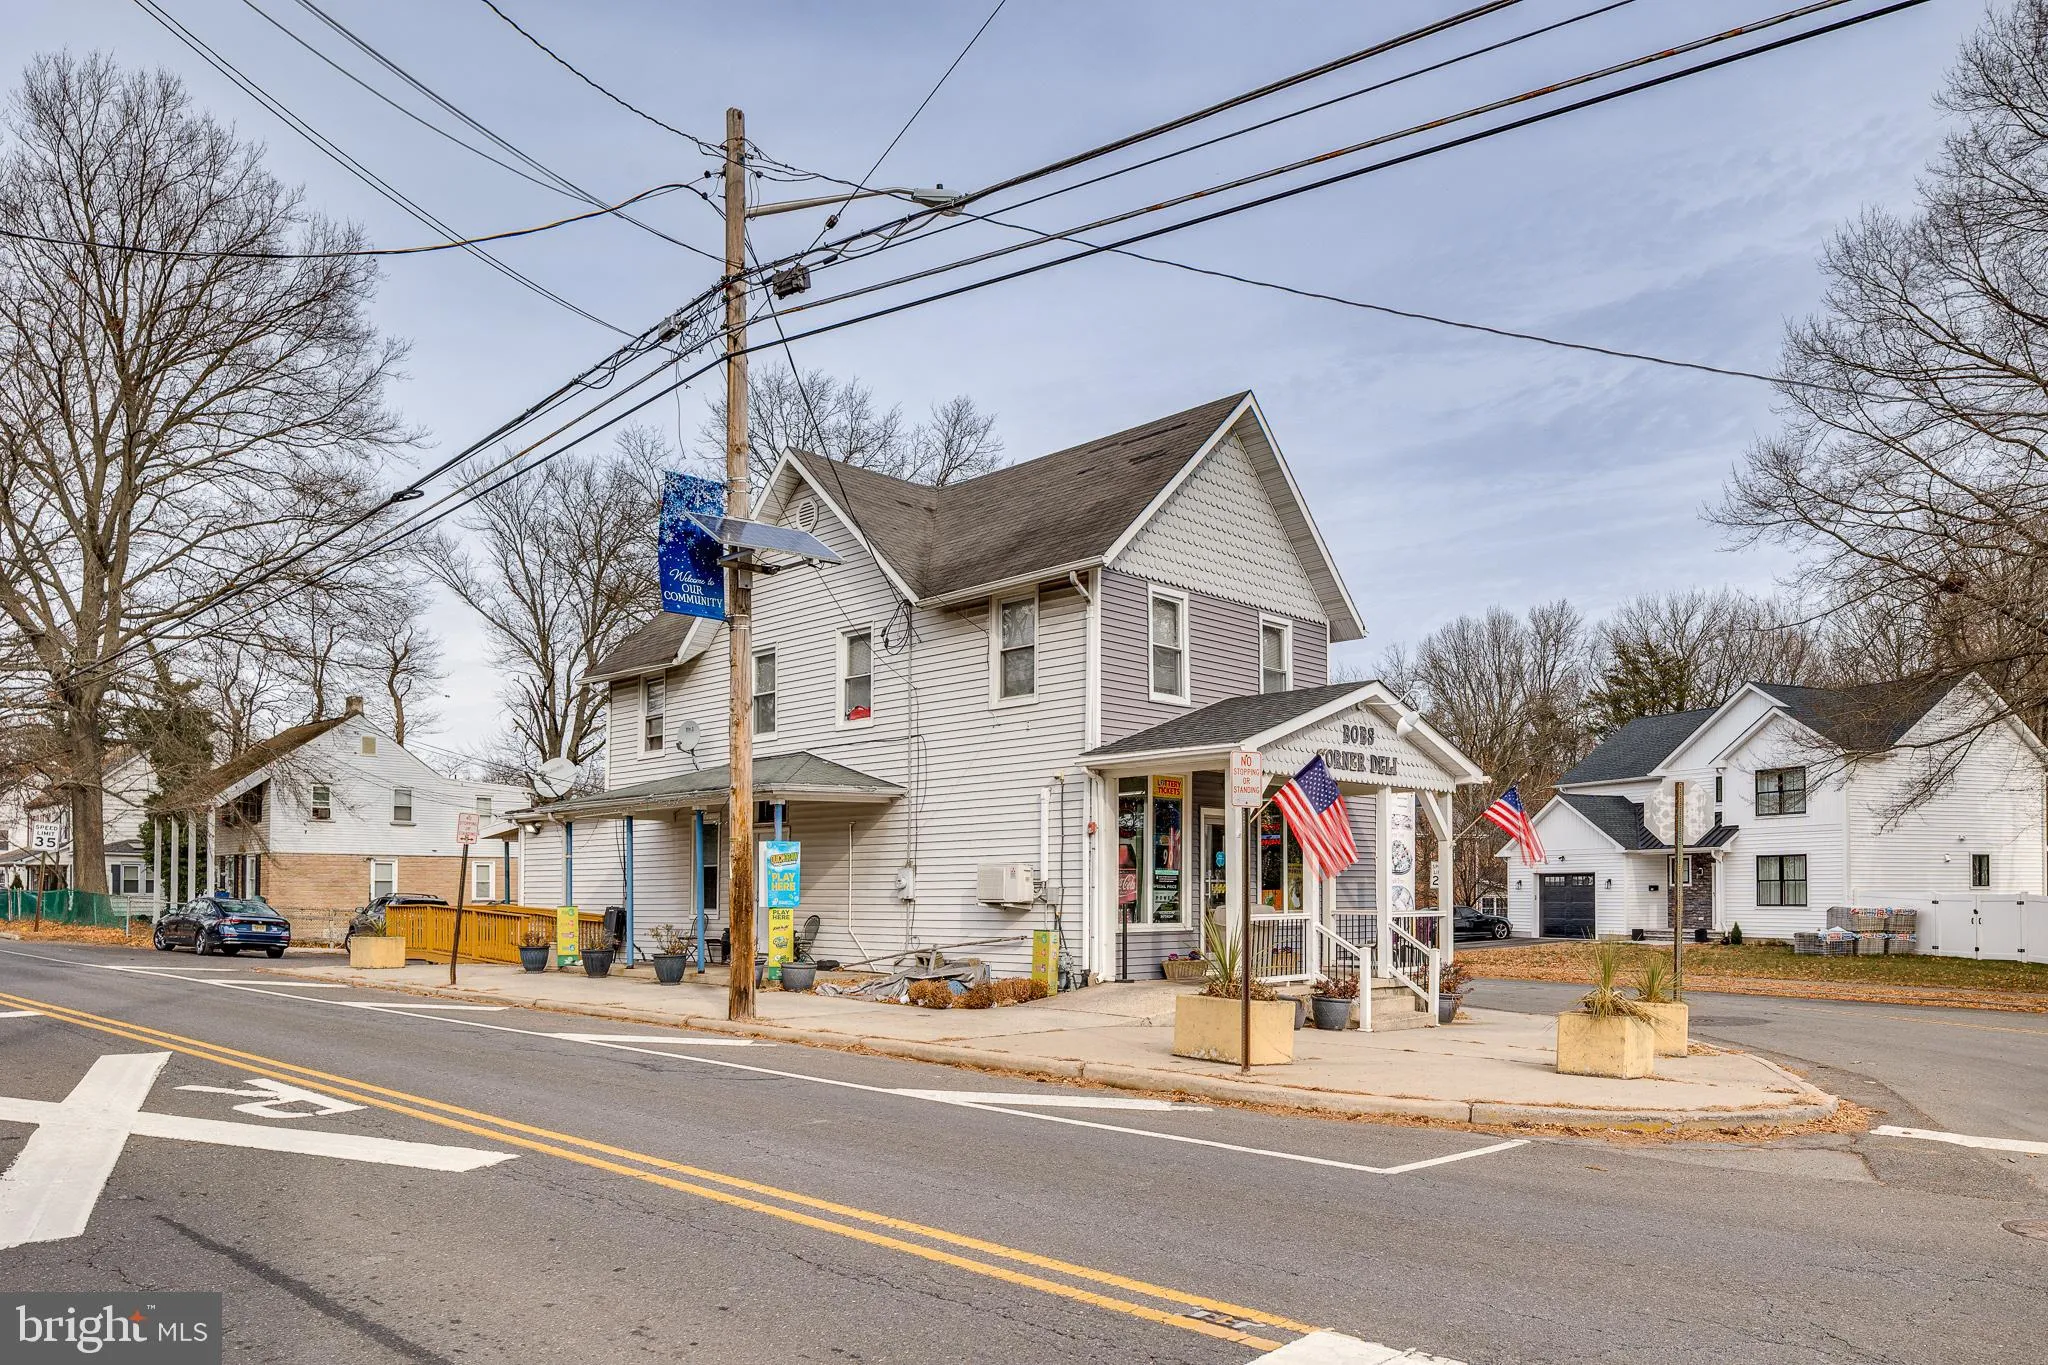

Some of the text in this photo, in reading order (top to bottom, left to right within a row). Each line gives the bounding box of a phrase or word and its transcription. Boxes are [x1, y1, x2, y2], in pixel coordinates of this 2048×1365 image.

[669, 568, 715, 586] Welcome to
[681, 583, 704, 595] OUR
[663, 590, 723, 608] COMMUNITY
[1342, 724, 1375, 745] BOBS
[1240, 756, 1252, 767] NO
[1369, 754, 1398, 776] DELI
[1233, 767, 1260, 776] STOPPING
[1157, 779, 1182, 788] LOTTERY
[1242, 777, 1251, 785] OR
[1157, 787, 1181, 796] TICKETS
[1233, 786, 1260, 794] STANDING
[34, 836, 56, 848] 35
[771, 872, 796, 882] PLAY
[771, 882, 796, 891] HERE
